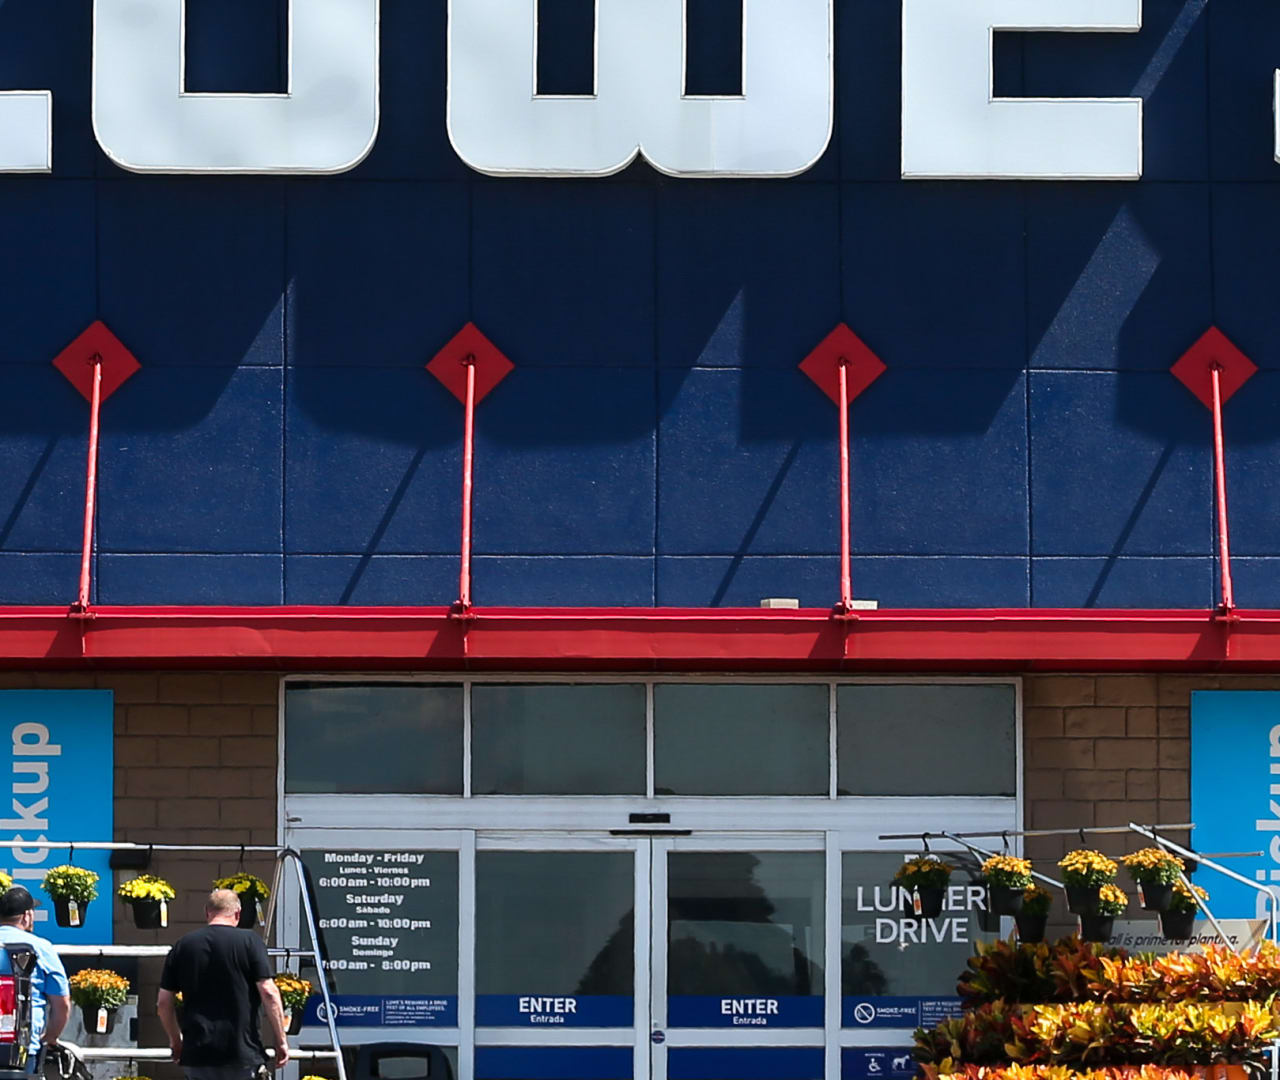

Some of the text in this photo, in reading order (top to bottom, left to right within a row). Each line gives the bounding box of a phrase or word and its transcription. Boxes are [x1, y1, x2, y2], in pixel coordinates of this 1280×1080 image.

[324, 853, 374, 864] Monday
[384, 853, 424, 864] Friday
[346, 894, 404, 905] Saturday
[857, 886, 986, 911] LUER
[876, 918, 968, 943] DRIVE
[351, 936, 398, 947] Sunday
[1108, 932, 1124, 945] all
[1187, 933, 1239, 948] plantg.
[352, 949, 394, 957] Domingo
[519, 997, 576, 1013] ENTER
[721, 999, 778, 1015] ENTER
[530, 1015, 564, 1023] Entrada
[733, 1016, 766, 1025] Entrada
